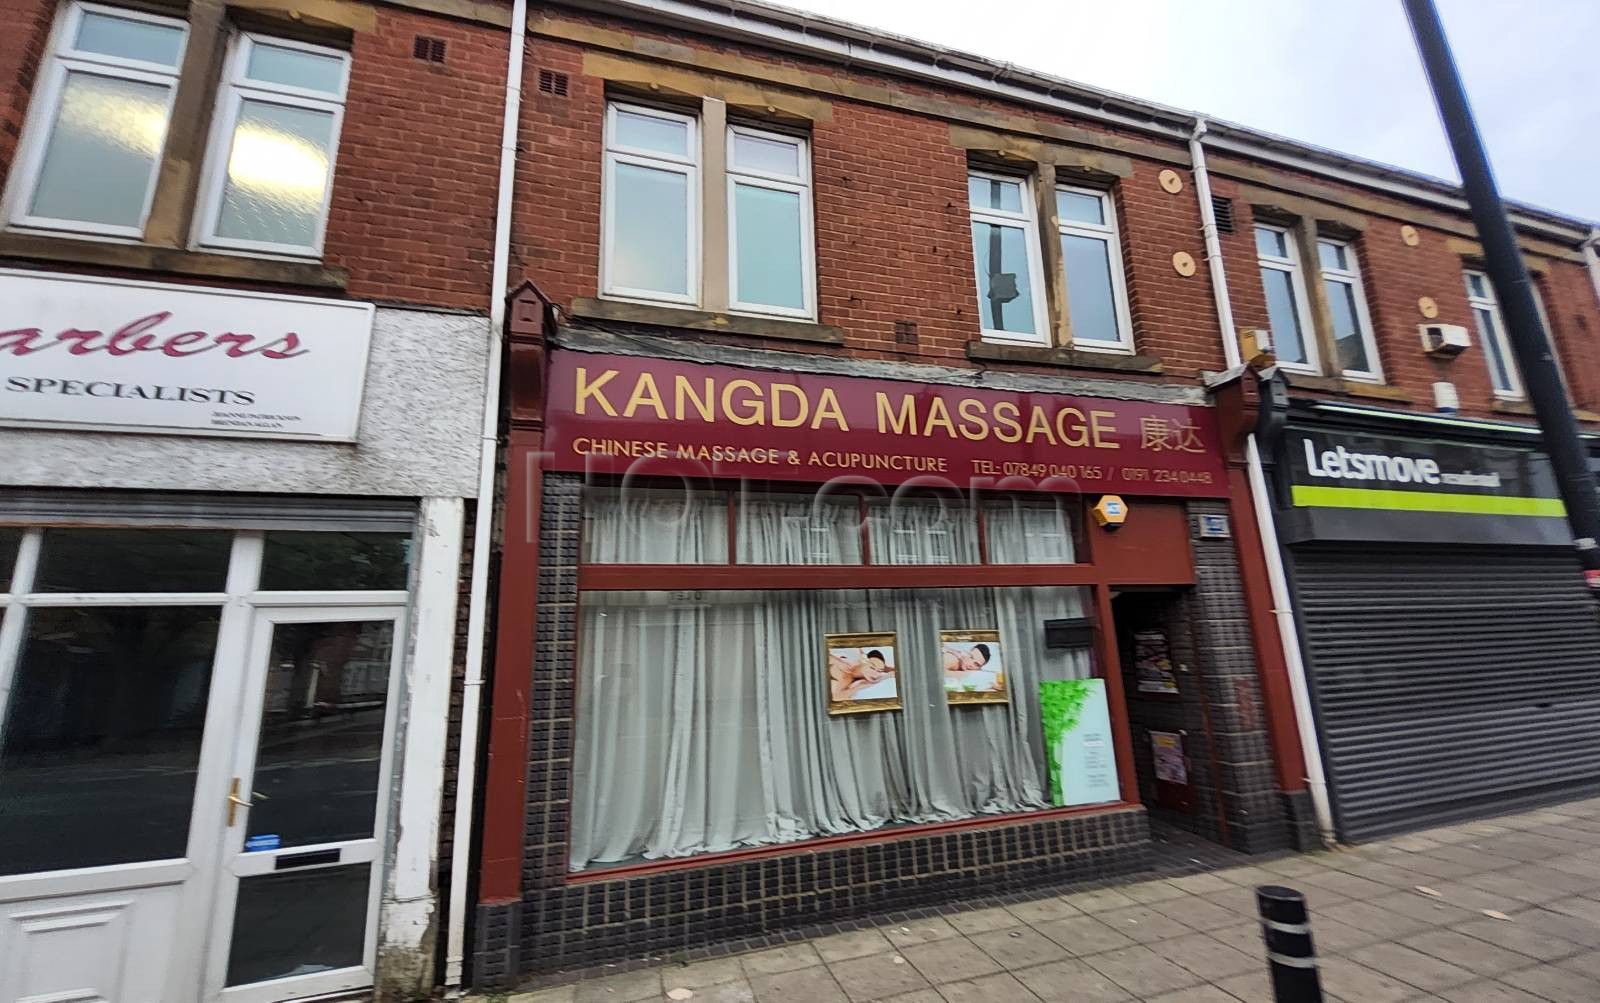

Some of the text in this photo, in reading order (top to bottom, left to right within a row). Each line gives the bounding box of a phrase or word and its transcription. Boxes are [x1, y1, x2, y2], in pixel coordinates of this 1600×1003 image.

[5, 377, 255, 405] SPECIALISTS
[574, 367, 1120, 450] KANGDA MASSAGE
[1138, 415, 1207, 454] 康达
[572, 437, 949, 473] CHINESE MASSAGE & ACUPUNCTURE
[1003, 462, 1047, 477] 07849
[1049, 464, 1077, 478] 040
[1079, 465, 1103, 479] 165
[1303, 437, 1440, 485] Letsmove
